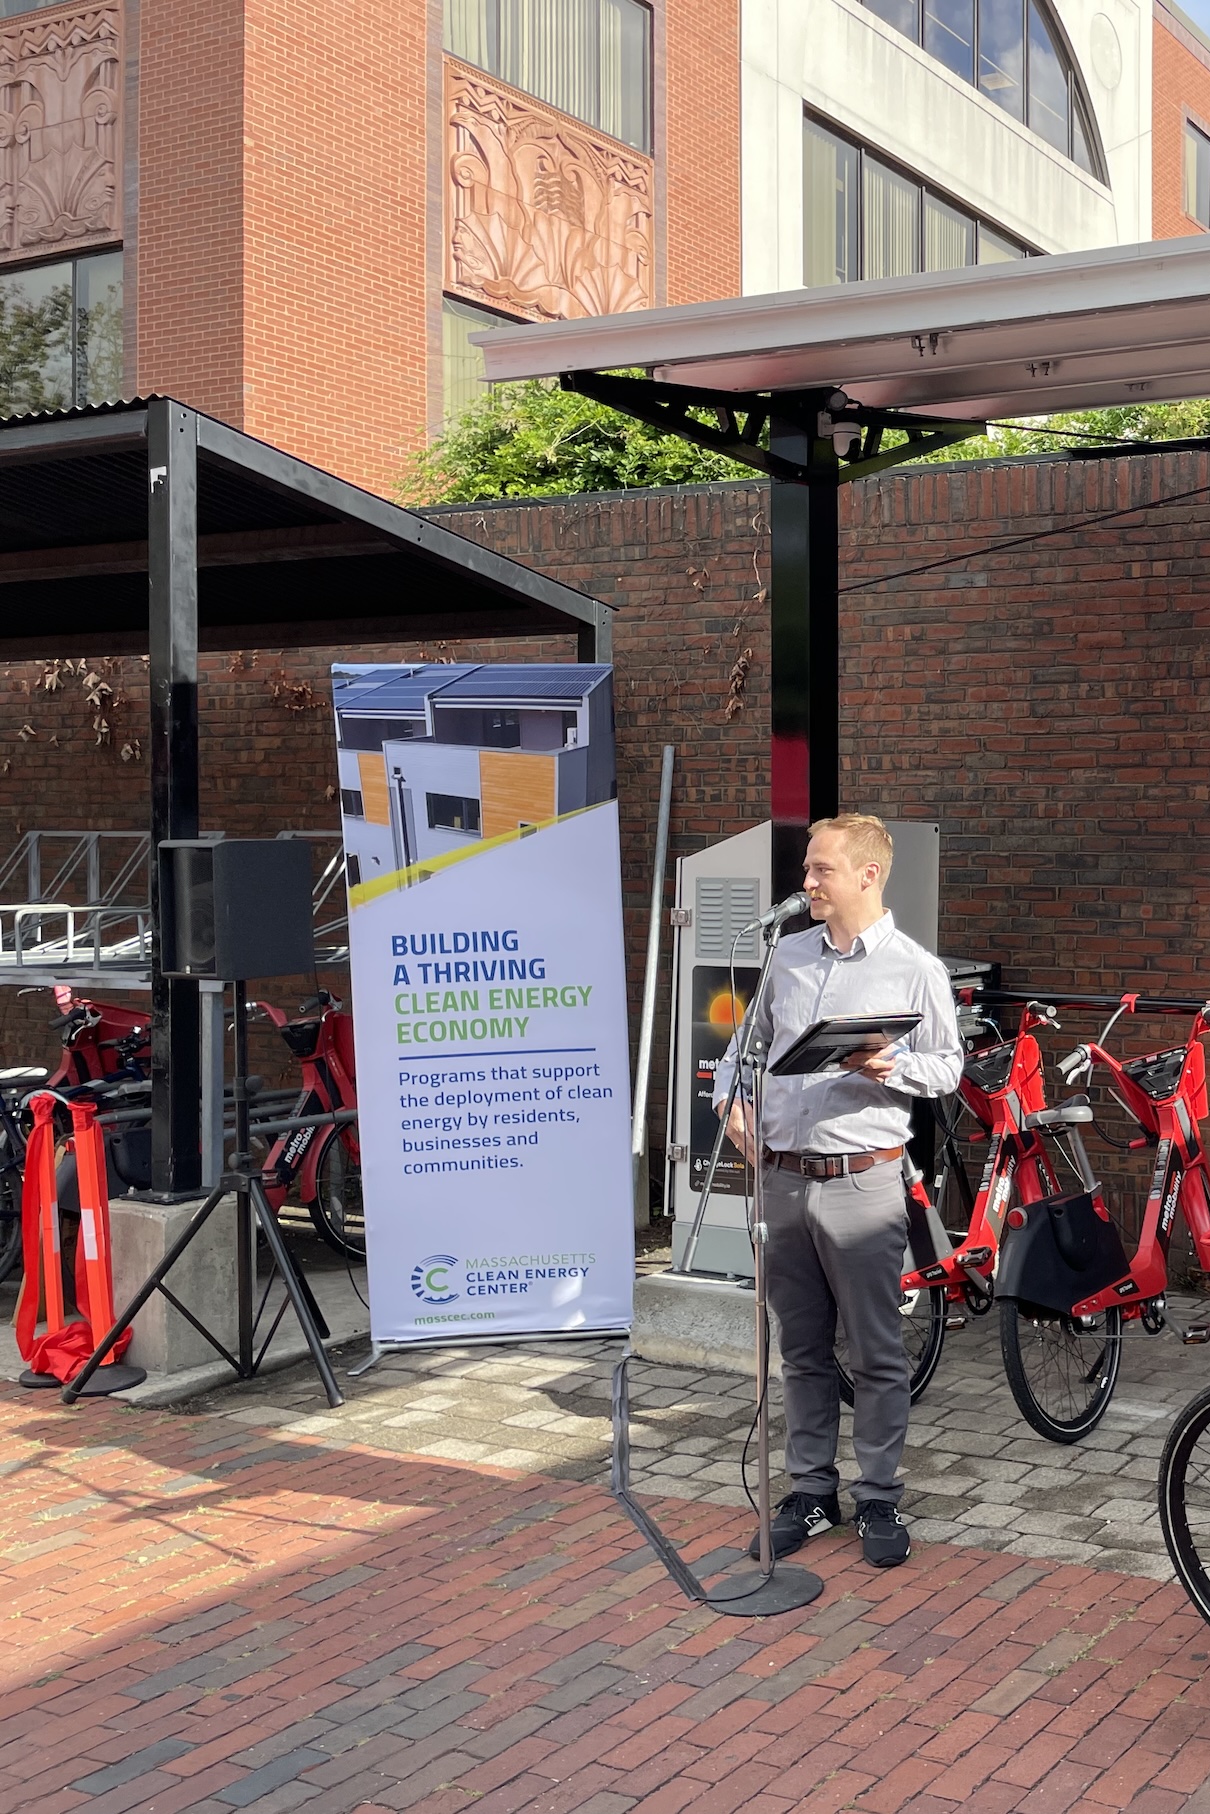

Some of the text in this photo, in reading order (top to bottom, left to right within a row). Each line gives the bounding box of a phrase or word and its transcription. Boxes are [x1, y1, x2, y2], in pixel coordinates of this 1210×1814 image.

[391, 930, 519, 956] BUILDING
[393, 958, 545, 985] A THRIVING
[395, 985, 593, 1015] CLEAN ENERGY
[396, 1016, 530, 1044] ECONOMY
[399, 1063, 600, 1087] Programs that support
[400, 1085, 613, 1108] the deployment of clean
[401, 1108, 580, 1131] energy by residents,
[284, 1133, 302, 1163] metro
[403, 1131, 538, 1152] businesses and
[403, 1155, 524, 1174] communities.
[1169, 1170, 1182, 1219] mobility
[1161, 1194, 1172, 1231] metro
[465, 1253, 596, 1269] MASSACHUSETTS
[466, 1267, 590, 1283] CLEAN ENERGY
[414, 1311, 495, 1326] masscec.com
